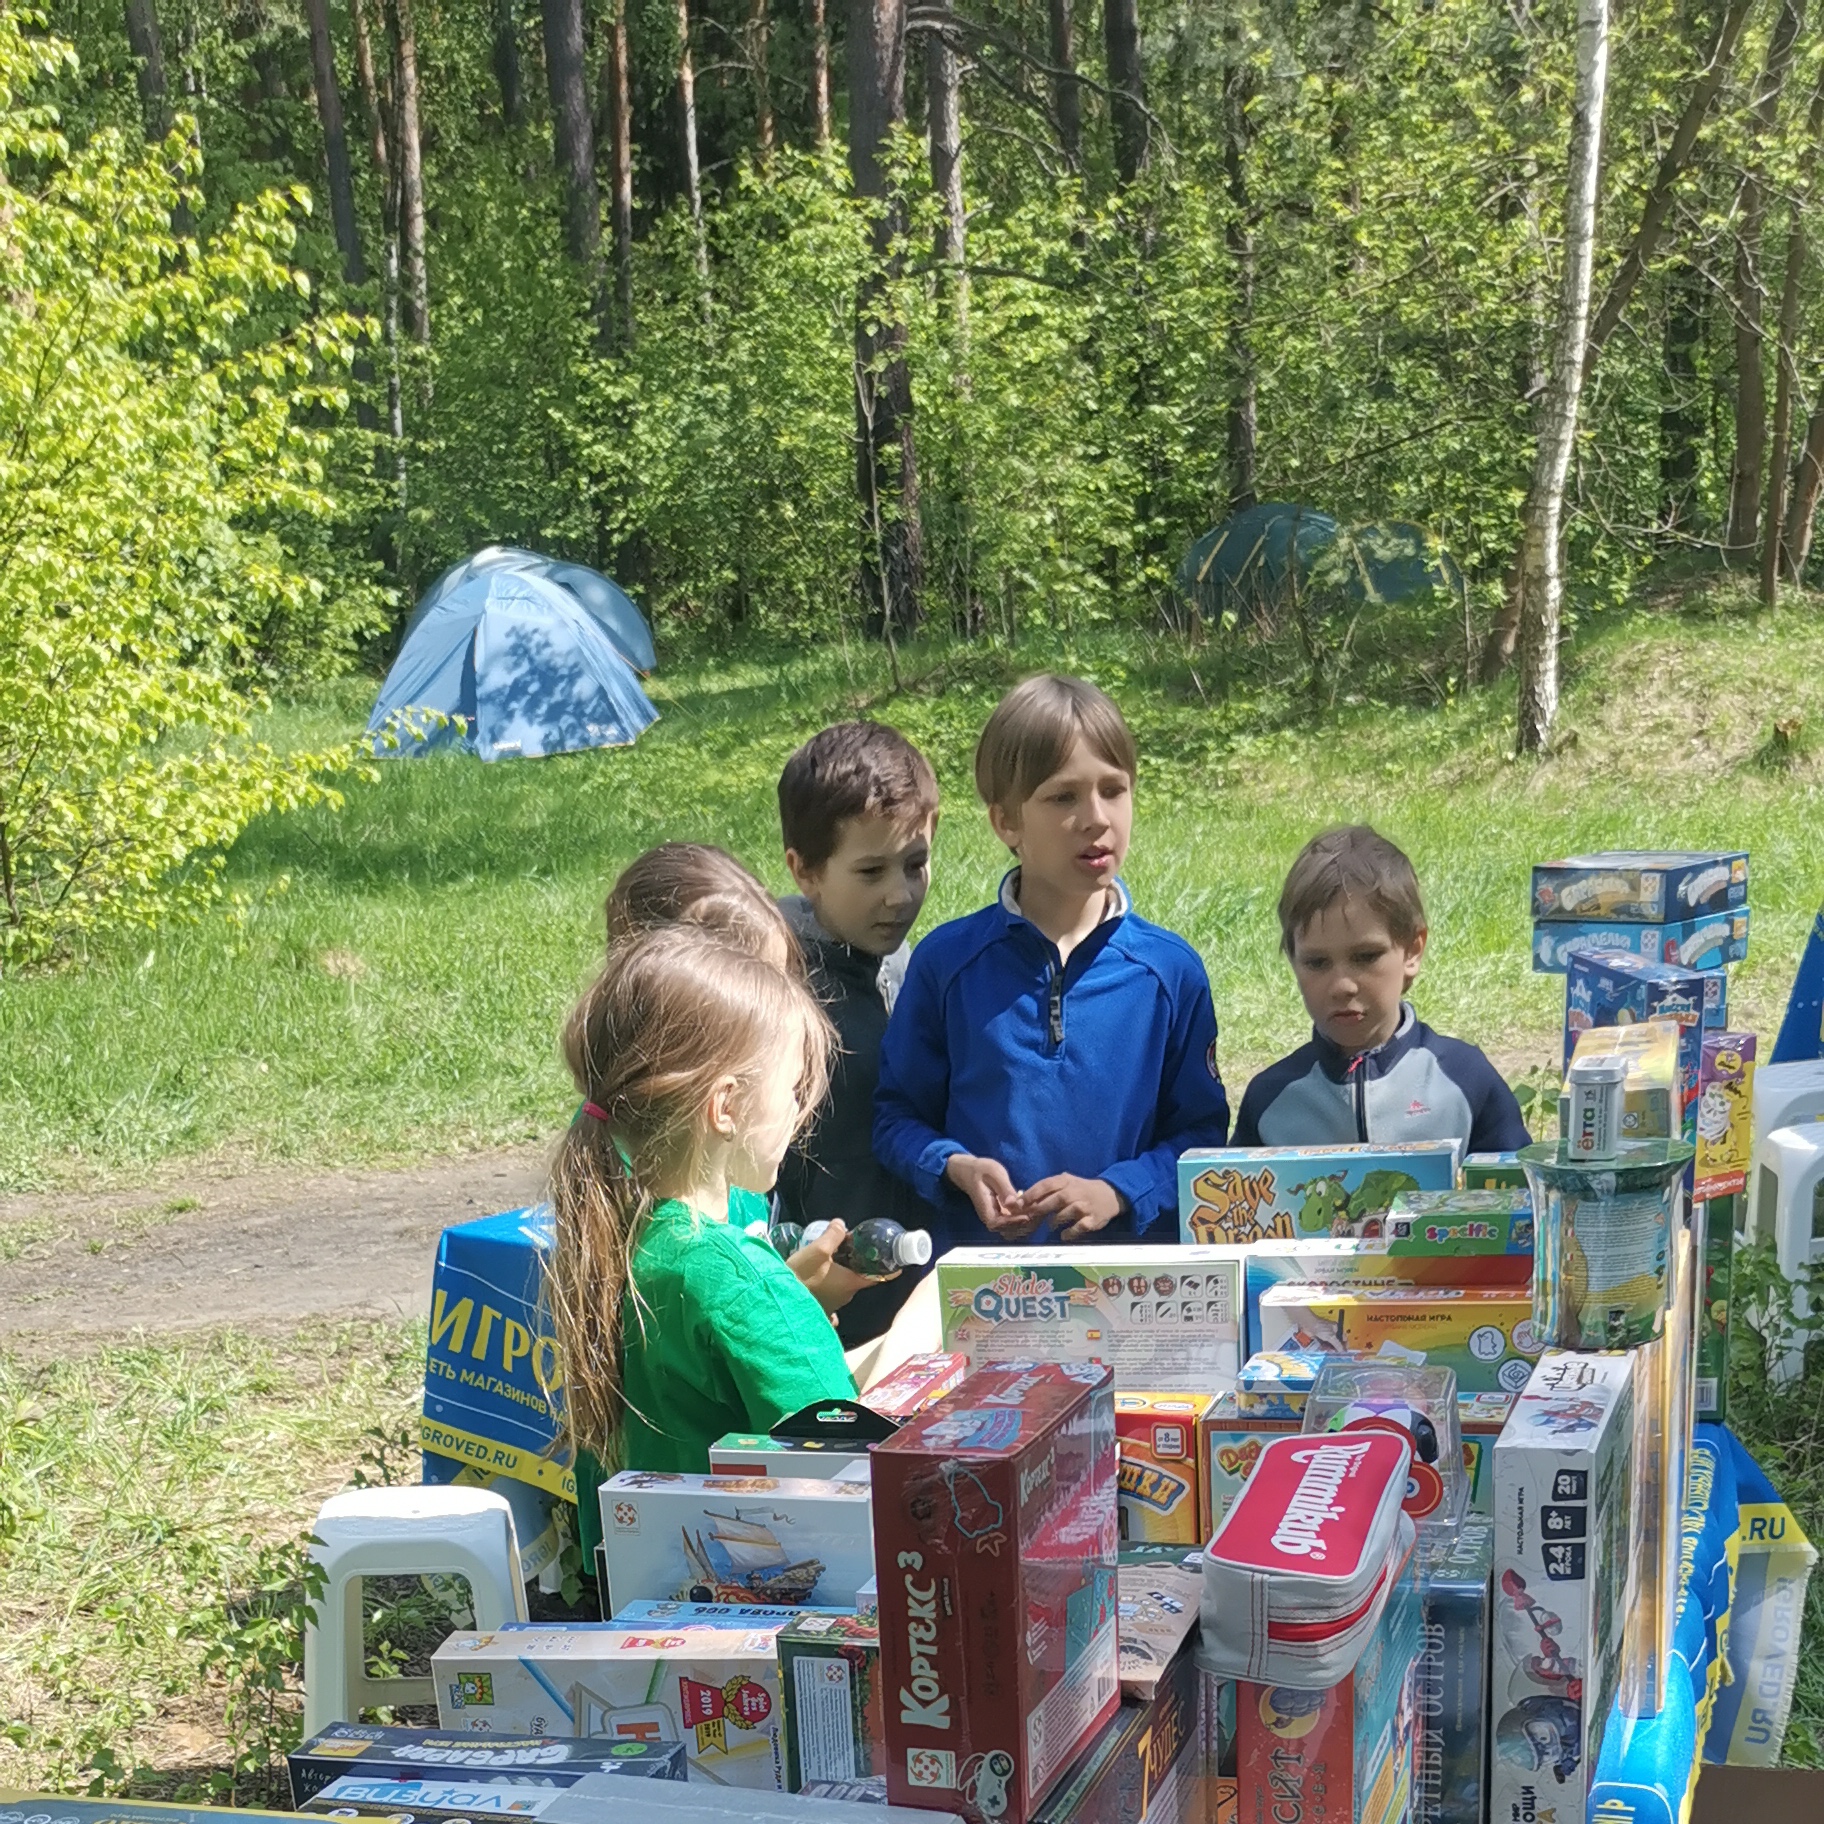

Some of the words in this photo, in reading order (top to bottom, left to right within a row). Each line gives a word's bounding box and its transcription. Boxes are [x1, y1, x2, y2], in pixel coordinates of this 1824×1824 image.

[1192, 1167, 1276, 1222] Save
[1228, 1201, 1255, 1230] the
[992, 1271, 1053, 1297] Slide
[973, 1288, 1071, 1323] QUEST
[431, 1289, 566, 1392] ИГРО
[428, 1358, 457, 1381] ЕТЬ
[460, 1369, 547, 1414] МАГАЗИНОВ
[1557, 1475, 1571, 1495] 20
[1547, 1510, 1564, 1530] 8+
[896, 1550, 924, 1572] 3
[899, 1573, 951, 1730] Кортекс
[1422, 1620, 1446, 1721] ОСТРОВ
[702, 1689, 711, 1717] 2019
